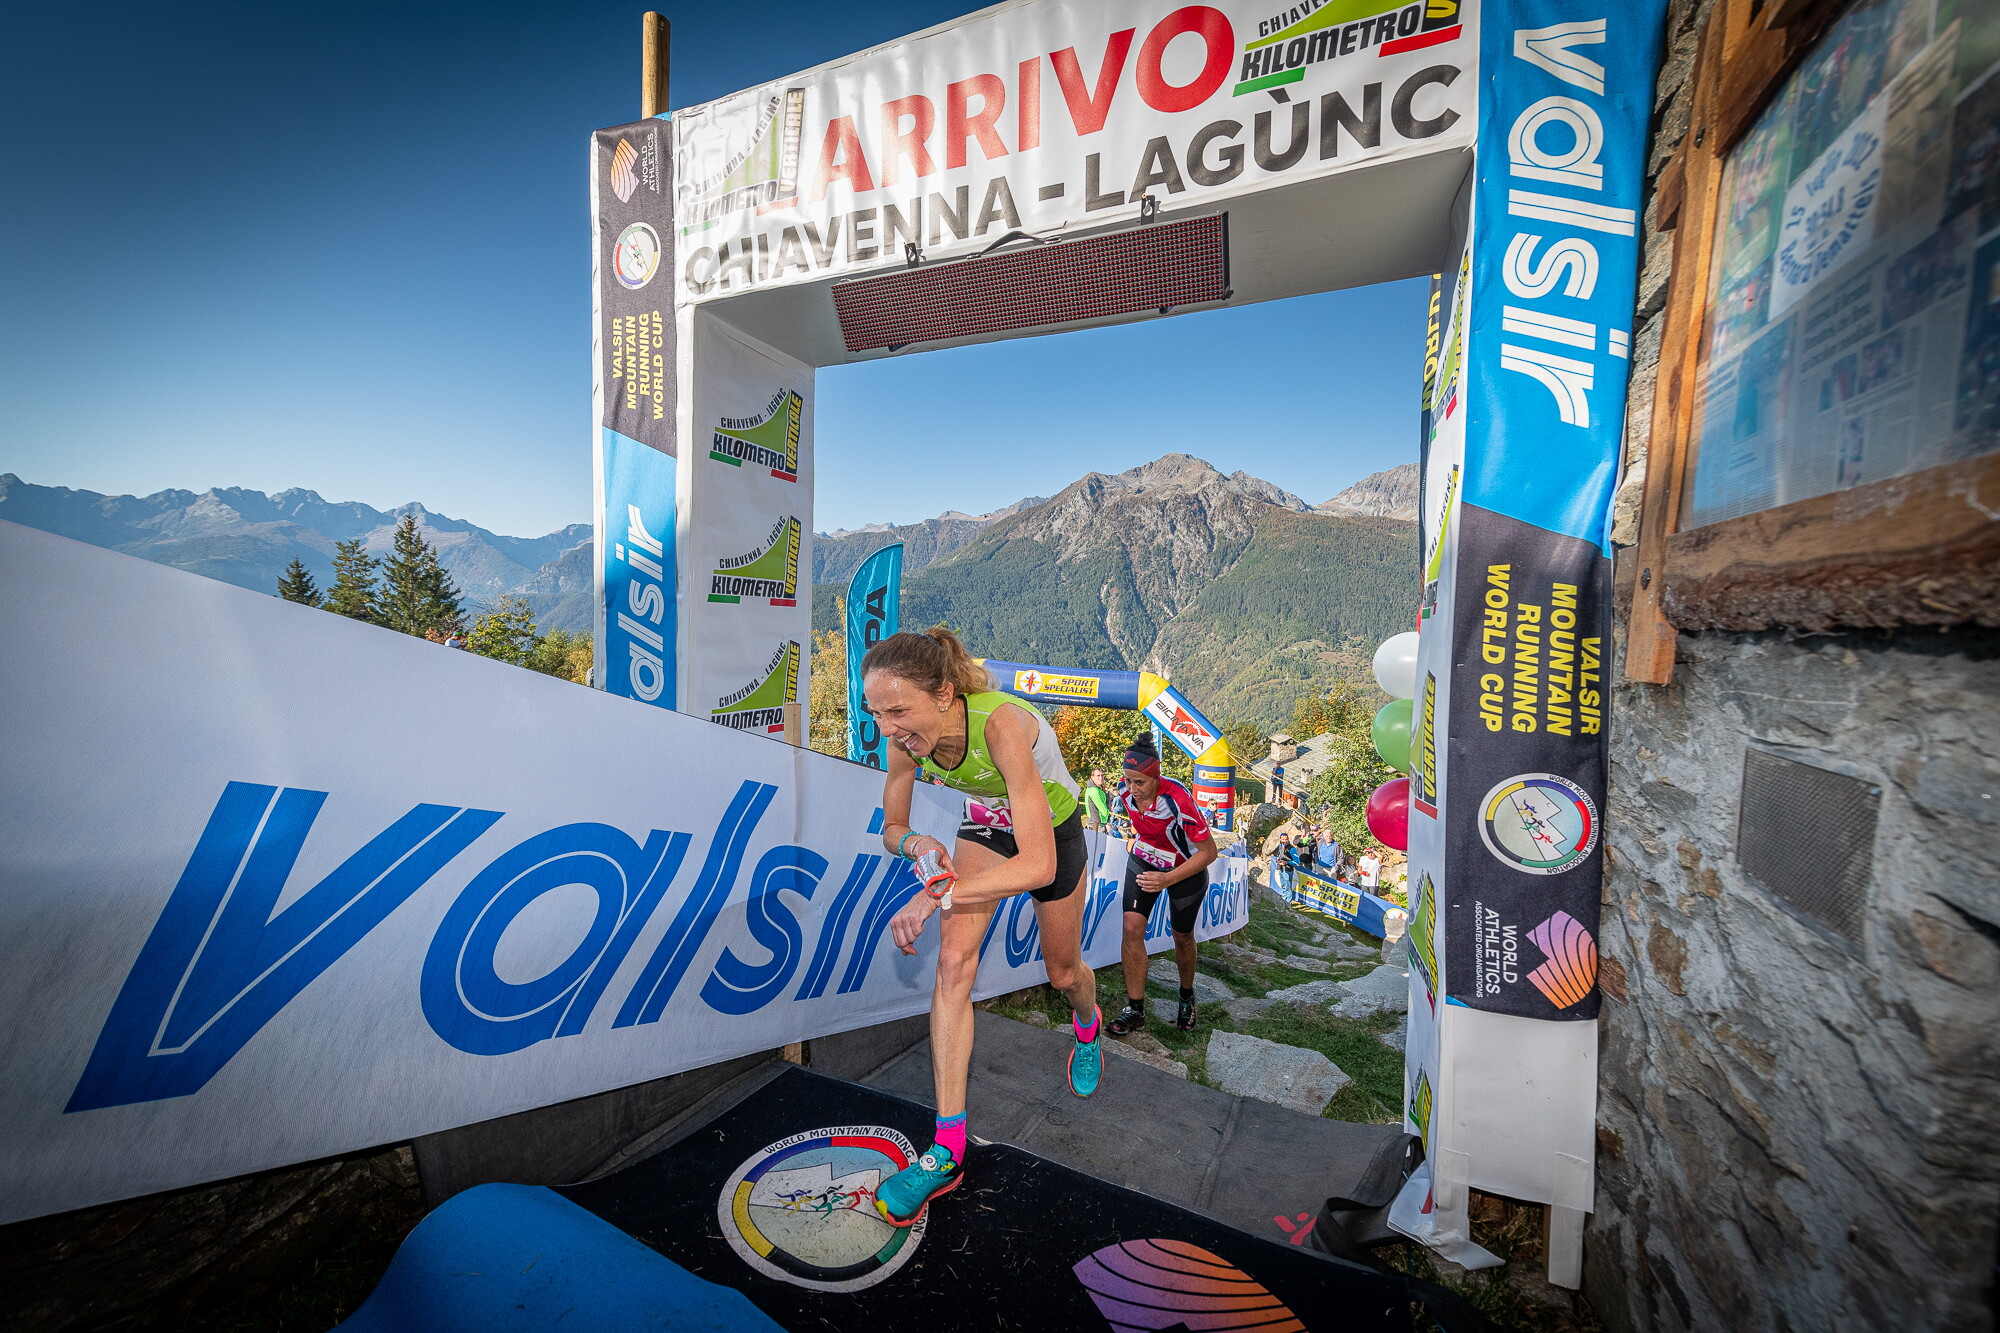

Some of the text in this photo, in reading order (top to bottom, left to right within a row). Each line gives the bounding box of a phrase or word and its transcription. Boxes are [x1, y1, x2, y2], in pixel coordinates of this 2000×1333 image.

[1240, 4, 1421, 82] KILOMETRO
[808, 5, 1235, 201] ARRIVO
[647, 132, 656, 191] ATHLETICS
[685, 175, 1022, 295] CHIAVENNA
[1085, 64, 1462, 212] LAGÙNC
[780, 92, 804, 192] VERTICALE
[612, 317, 623, 380] VALSIR
[626, 315, 637, 410] MOUNTAIN
[639, 313, 650, 396] RUNNING
[652, 310, 664, 420] WORLD CUP
[713, 432, 785, 470] KILOMETRO
[720, 413, 764, 429] CHIAVENNA
[786, 393, 803, 470] VERTICALE
[711, 575, 785, 598] KILOMETRO
[719, 547, 762, 568] CHIAVENNA
[785, 519, 801, 594] VERTICALE
[615, 503, 665, 701] alsir
[785, 643, 800, 703] ERTICALE
[1061, 678, 1096, 687] SPORT
[1479, 564, 1511, 732] WORLD CUP
[1511, 603, 1542, 733] RUNNING
[1546, 582, 1578, 737] MOUNTAIN
[718, 678, 760, 708] CHIAVENNA
[1043, 684, 1094, 695] SPECIALIST
[1579, 637, 1601, 735] VALSIR
[1423, 675, 1436, 798] VERTICALE
[1141, 851, 1166, 868] 229
[1546, 774, 1599, 875] WORLD MOUNTAIN RUNNING ASSOCIATION
[1300, 884, 1355, 911] SPECIALIST
[1319, 882, 1357, 903] SPORT
[1475, 944, 1484, 998] ORGANISATIONS
[1485, 907, 1501, 995] ATHLETICS
[1502, 924, 1518, 984] WORLD
[764, 1126, 917, 1160] WORLD MOUNTAIN RUNNING
